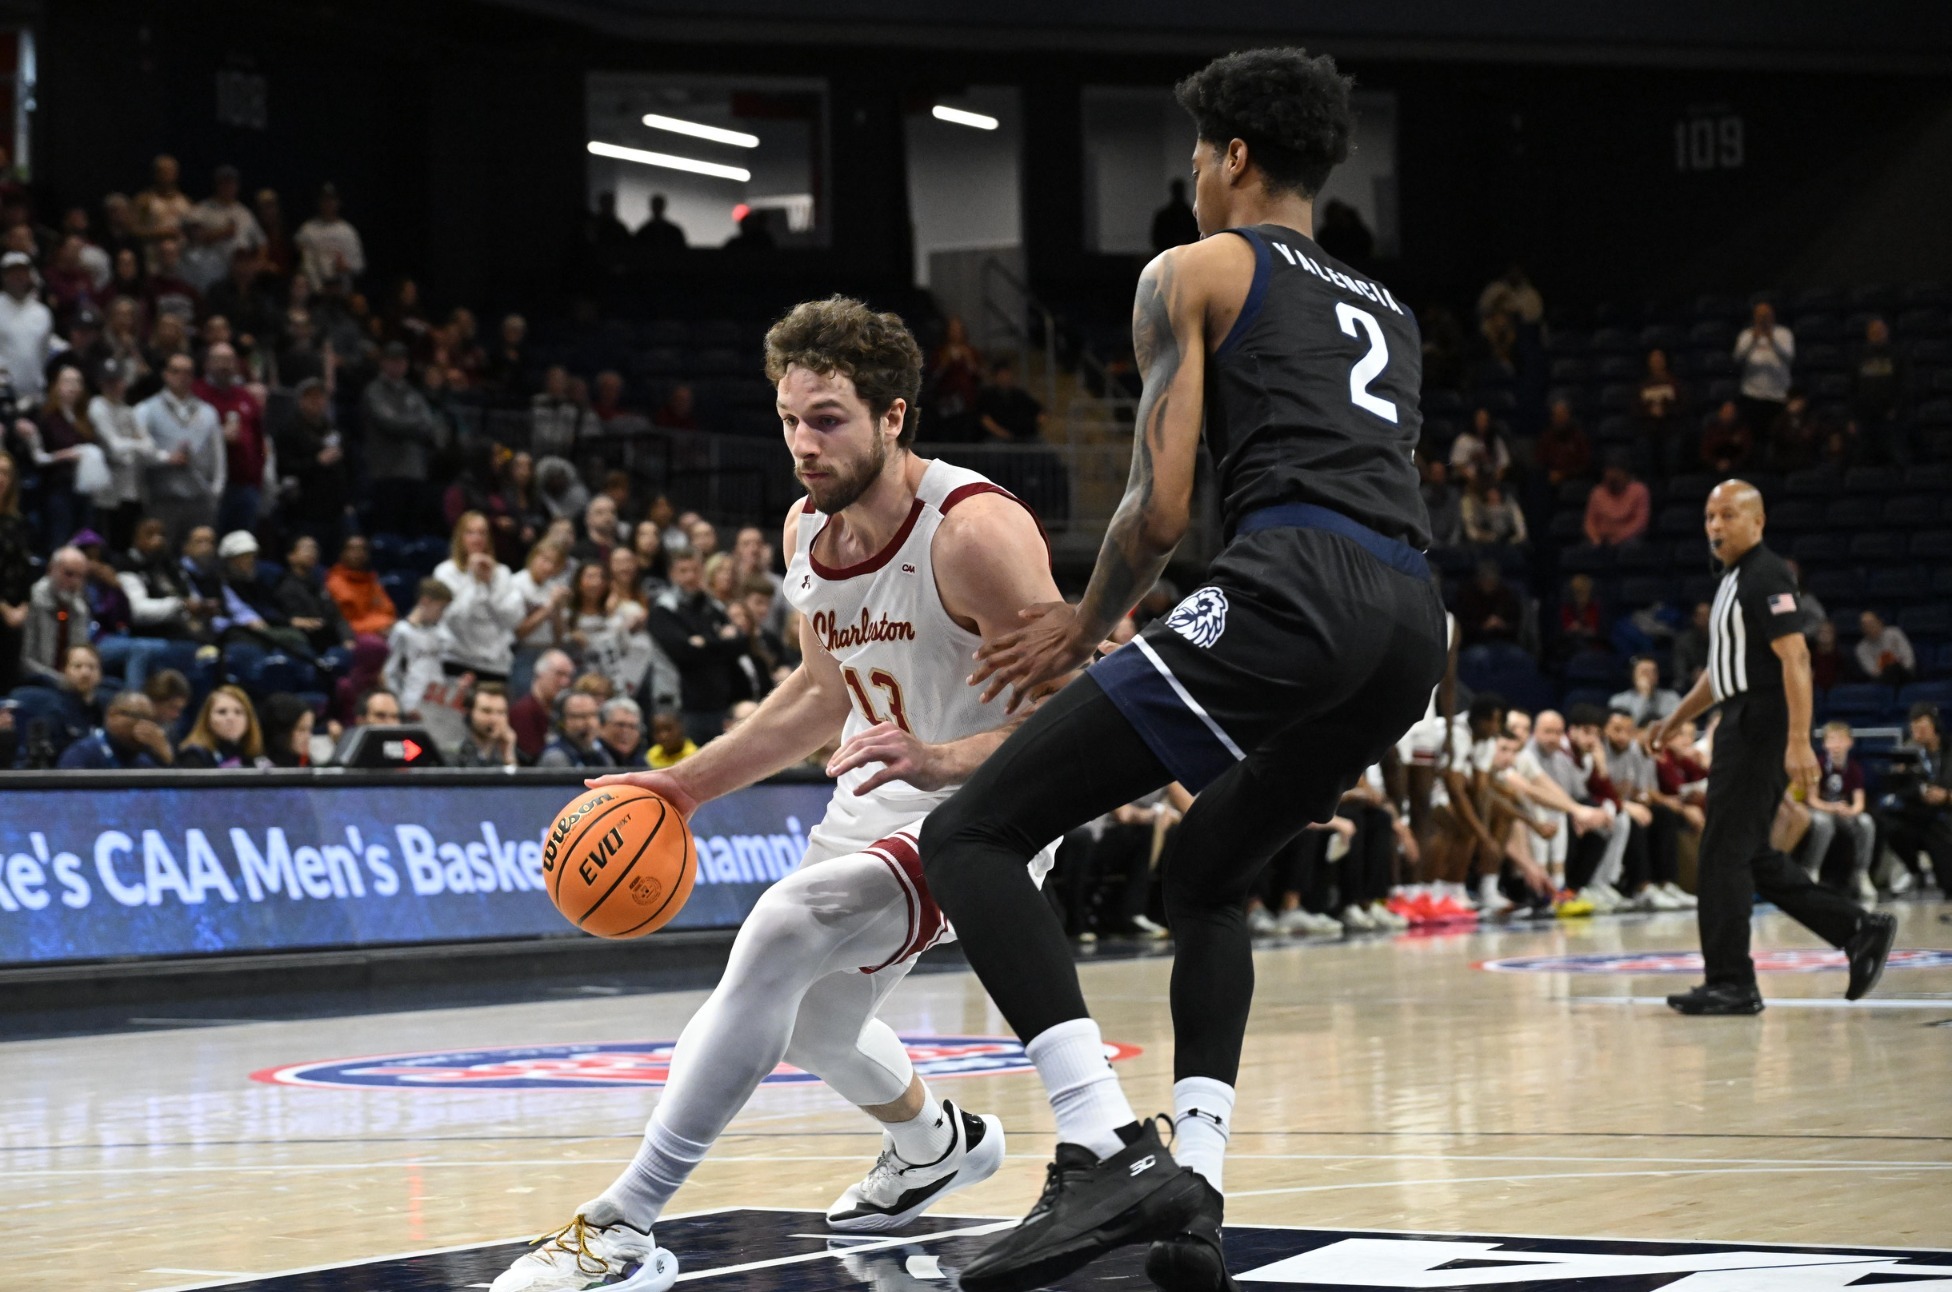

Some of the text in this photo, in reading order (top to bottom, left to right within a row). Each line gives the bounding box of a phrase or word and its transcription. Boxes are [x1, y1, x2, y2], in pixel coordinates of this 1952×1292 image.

[1674, 116, 1744, 172] 109
[1272, 242, 1404, 315] VALENCIA
[1335, 301, 1399, 424] 2
[902, 563, 916, 574] CAA
[94, 829, 239, 906] CAA
[229, 825, 399, 901] Men's
[395, 821, 549, 895] Baske
[543, 792, 615, 872] Wilson
[578, 827, 624, 886] EVO
